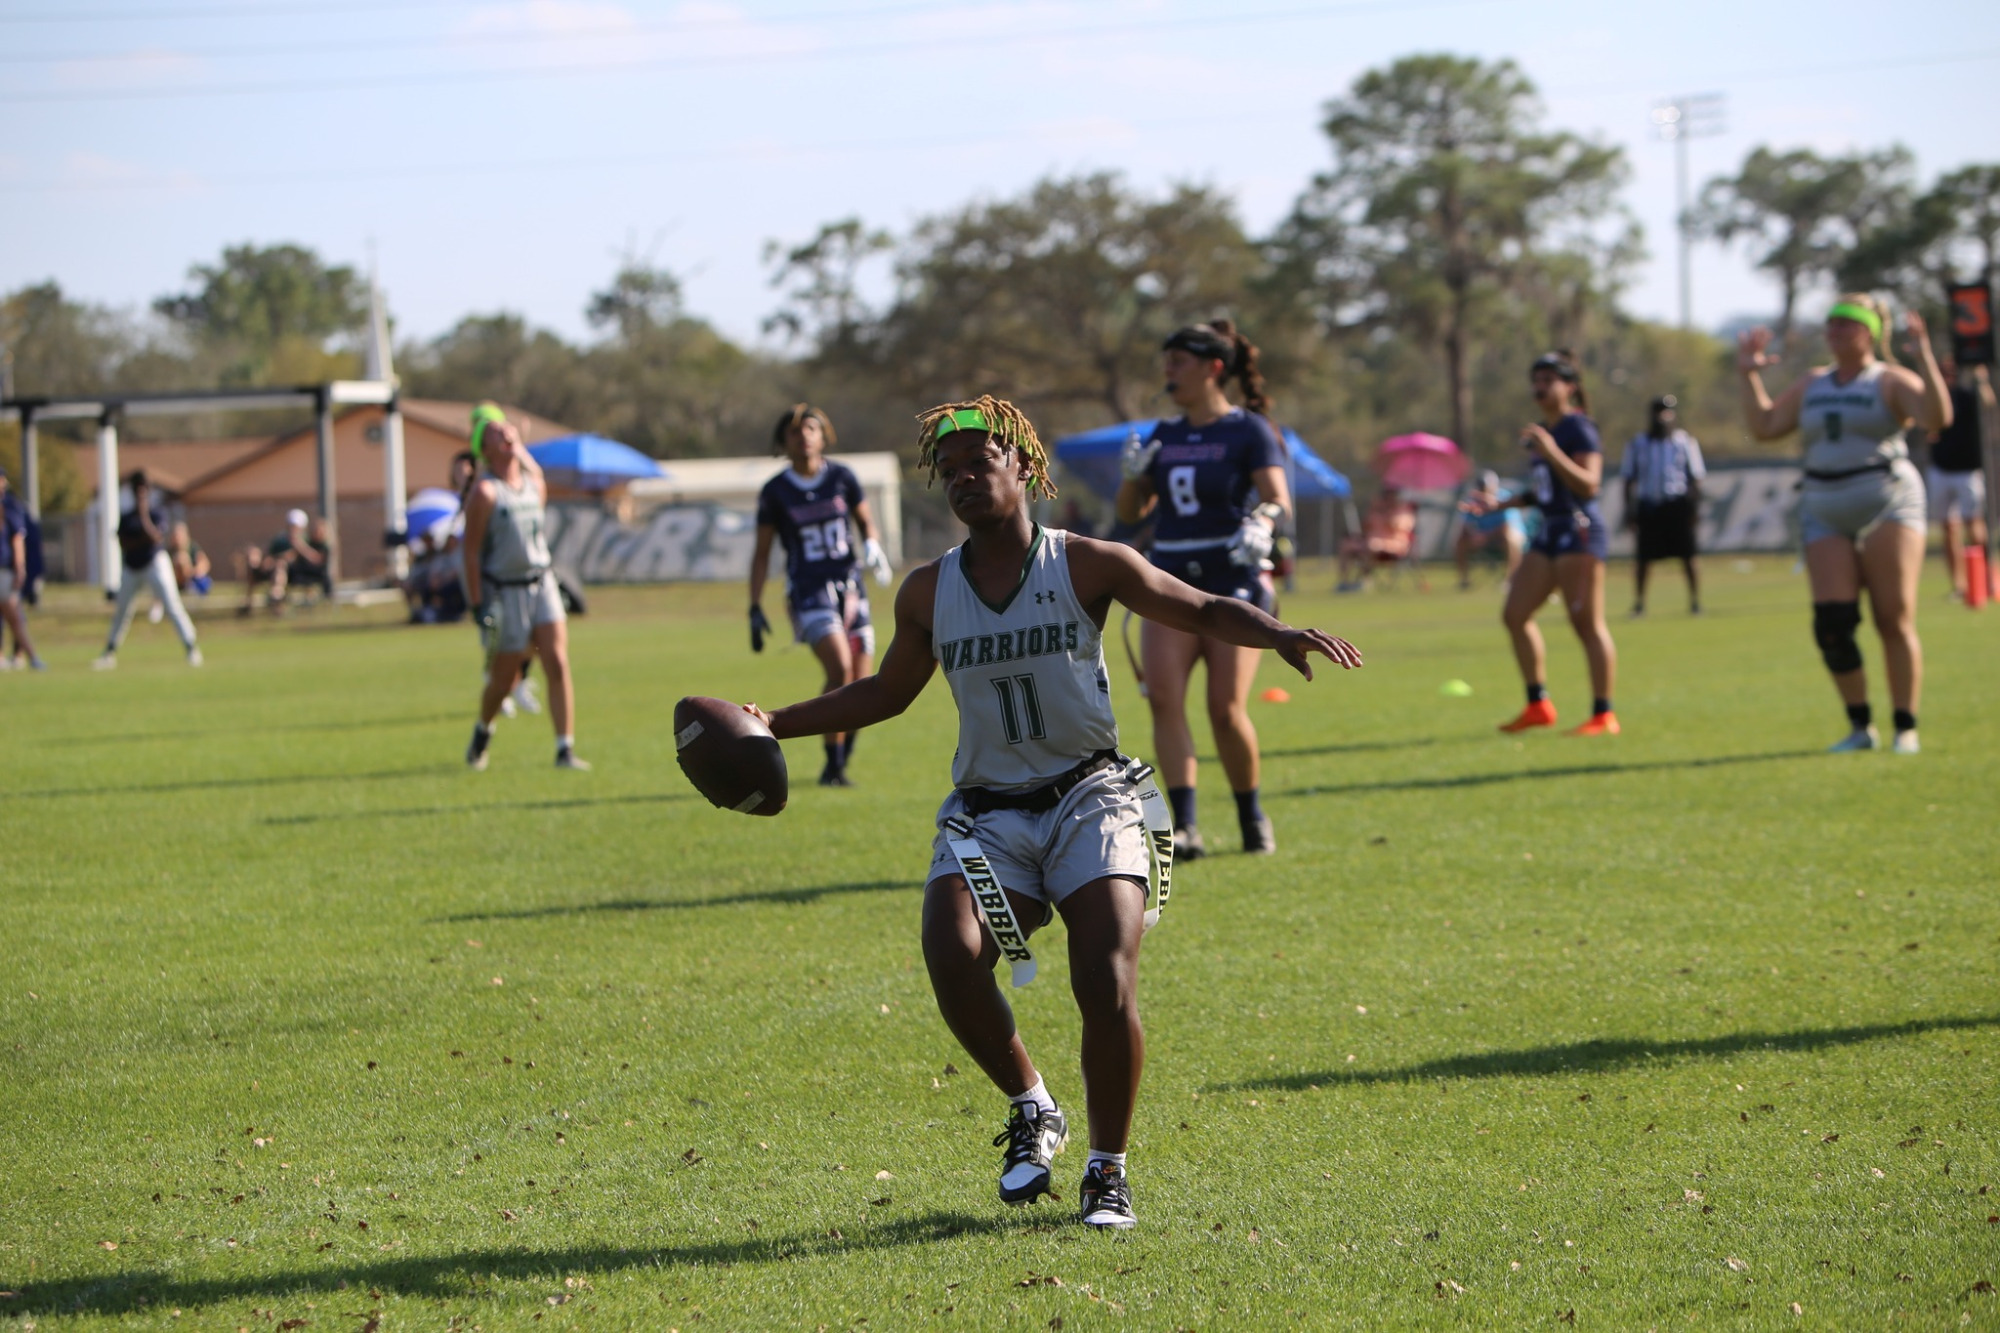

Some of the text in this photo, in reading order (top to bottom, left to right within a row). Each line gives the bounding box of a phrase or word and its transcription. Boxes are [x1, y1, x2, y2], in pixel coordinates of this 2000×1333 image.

[1953, 287, 1990, 335] 3
[1168, 465, 1200, 517] 8
[800, 520, 849, 561] 20
[940, 620, 1079, 673] WARRIORS
[990, 672, 1046, 744] 11
[961, 855, 1032, 962] WEBBER
